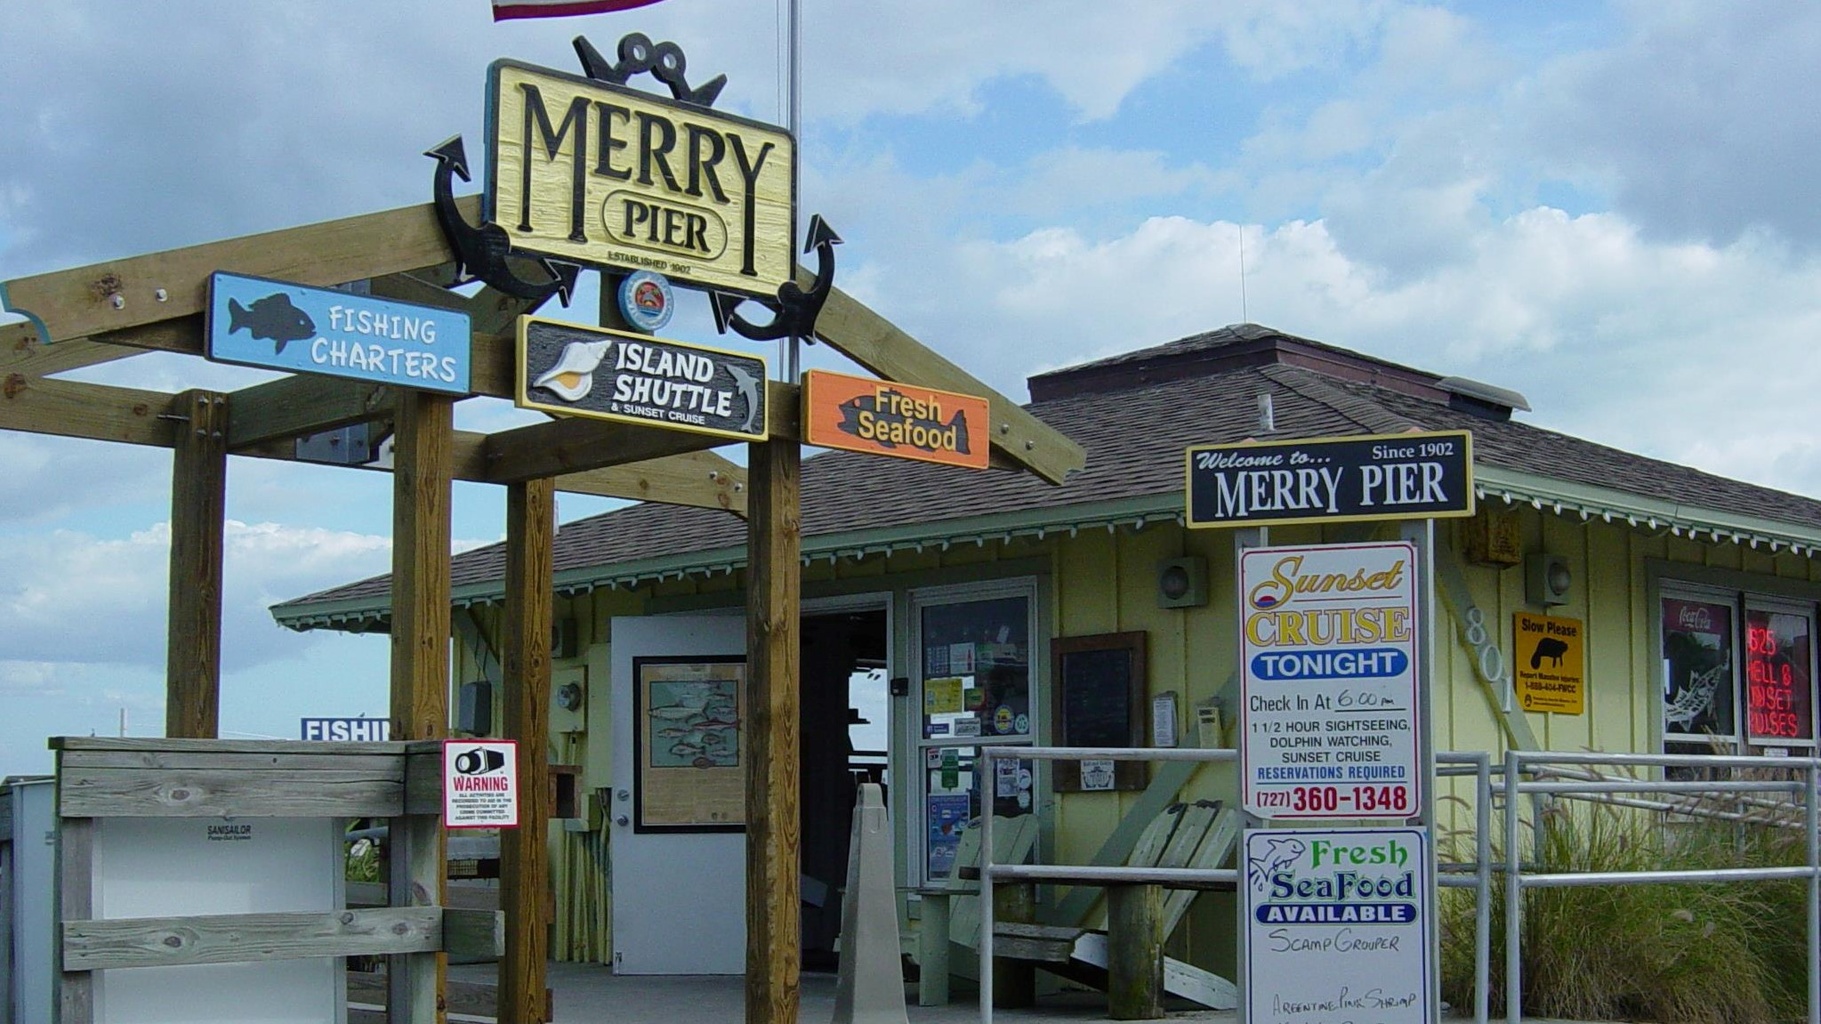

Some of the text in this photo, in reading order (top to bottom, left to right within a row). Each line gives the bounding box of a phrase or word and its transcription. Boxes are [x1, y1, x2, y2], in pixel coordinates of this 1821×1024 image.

[517, 82, 775, 277] MERRY
[622, 198, 711, 253] PIER
[607, 250, 691, 275] ESTABLISHED 1902
[329, 305, 437, 344] FISHING
[311, 337, 456, 383] CHARTERS
[615, 342, 714, 383] ISLAND
[612, 373, 733, 418] SHUTTLE
[875, 385, 942, 422] Fresh
[611, 402, 705, 425] & SUNSET CRUISE
[858, 410, 957, 451] Seafood
[1196, 442, 1454, 470] Welcome to... Since 1902
[1214, 461, 1449, 518] MERRY PIER
[1249, 555, 1405, 611] Sunset
[1246, 606, 1411, 647] CRUISE
[1522, 618, 1577, 637] Slow Please
[1260, 651, 1398, 677] TONIGHT
[1250, 695, 1291, 712] Check
[1297, 694, 1309, 711] In
[1314, 693, 1331, 711] At
[1252, 719, 1411, 733] 1 1/2 HOUR SIGHTSEEING,
[1270, 735, 1393, 748] DOLPHIN WATCHING,
[1282, 751, 1381, 763] SUNSET CRUISE
[453, 776, 508, 791] WARNING
[1258, 765, 1405, 780] RESERVATIONS REQUIRED
[1256, 786, 1407, 811] (727) 360-1348
[1311, 839, 1408, 869] Fresh
[1270, 871, 1414, 901] SeaFood
[1267, 905, 1406, 922] AVAILABLE
